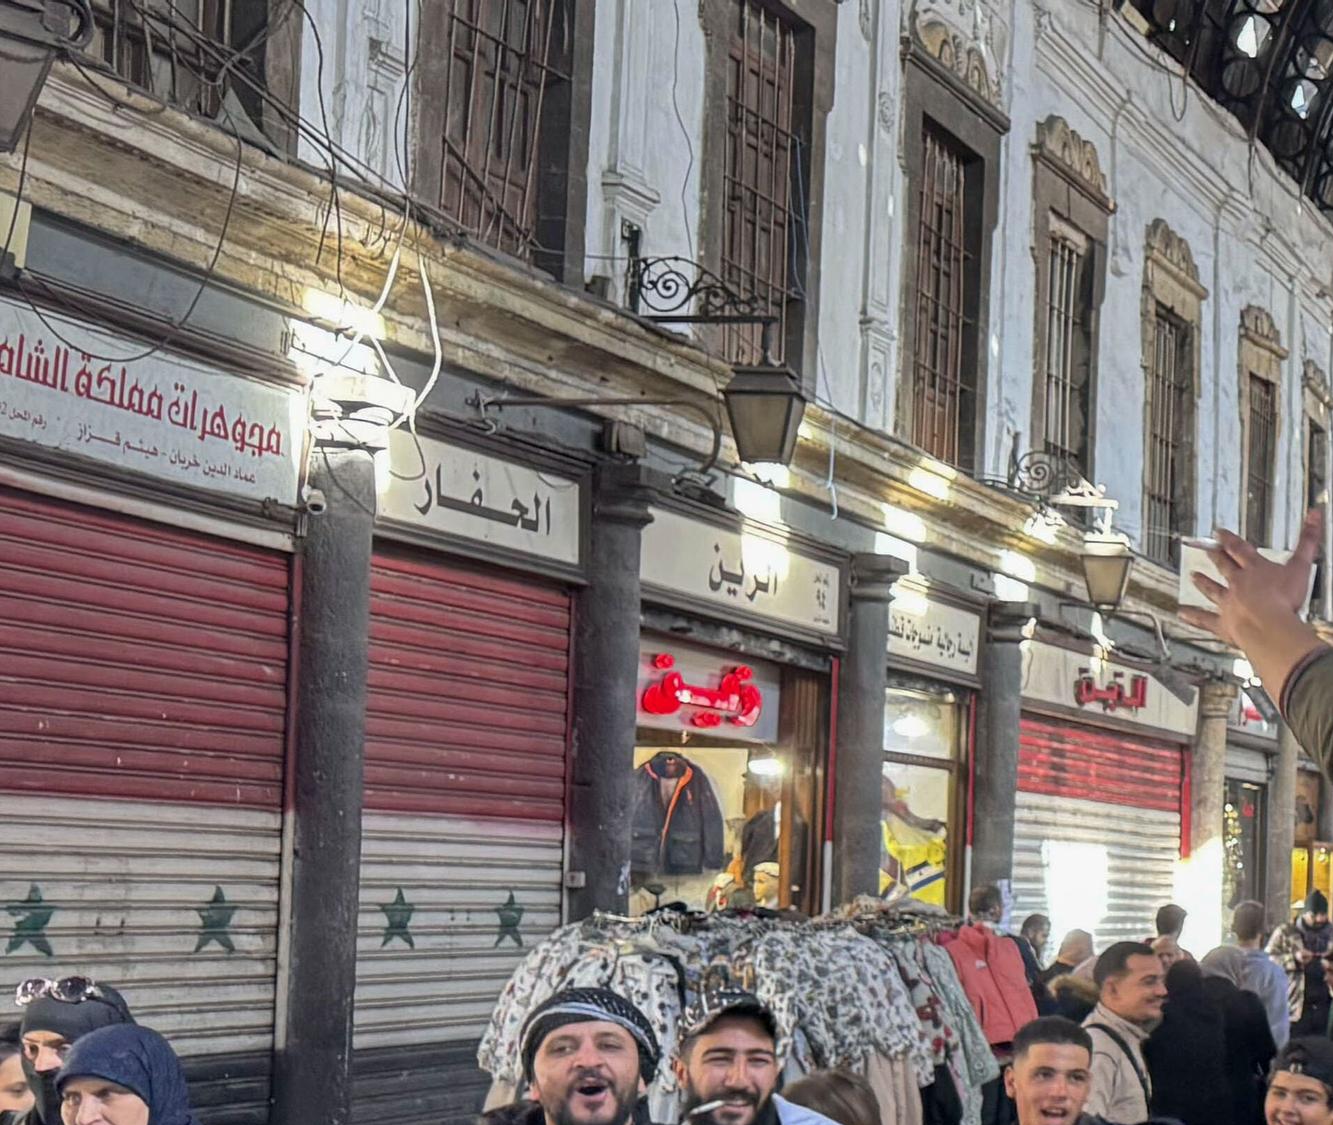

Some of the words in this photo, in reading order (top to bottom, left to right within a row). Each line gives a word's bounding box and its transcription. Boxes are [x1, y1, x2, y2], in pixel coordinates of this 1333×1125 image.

[75, 353, 163, 421] مملكة
[168, 381, 284, 457] مجوهرات
[203, 460, 231, 478] الدين
[234, 466, 256, 484] عماد
[414, 463, 550, 536] الحفار
